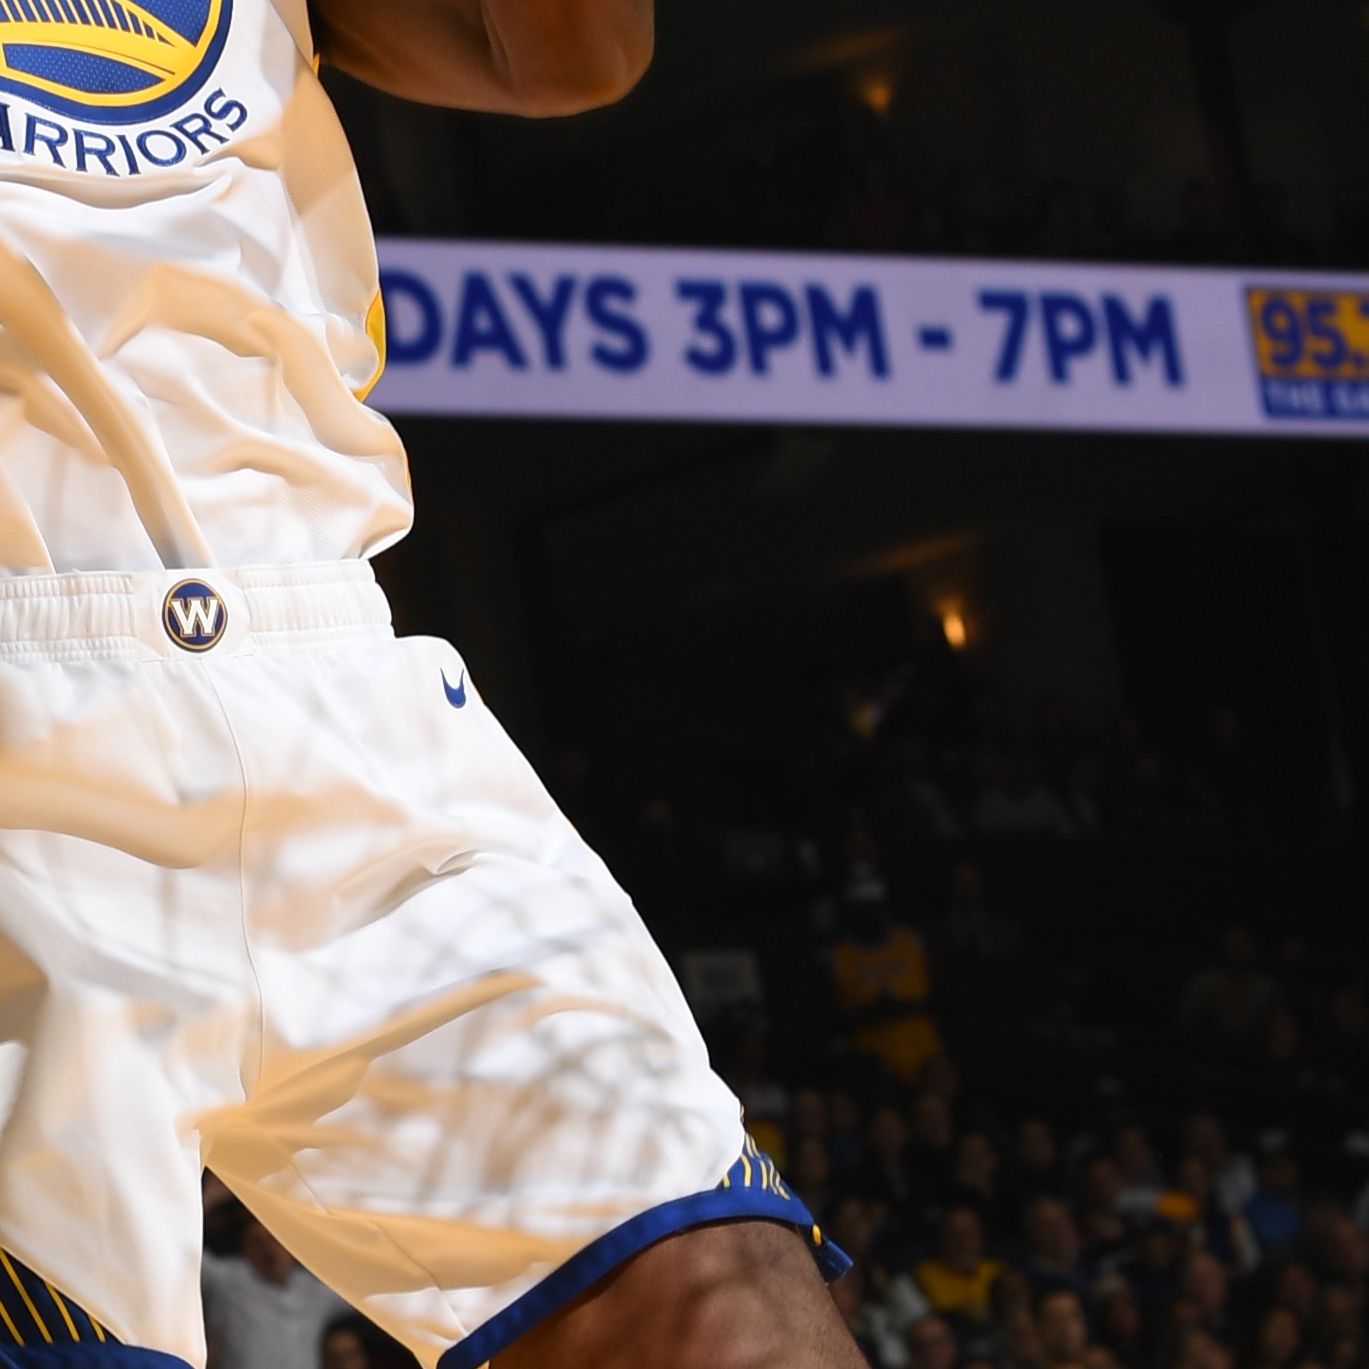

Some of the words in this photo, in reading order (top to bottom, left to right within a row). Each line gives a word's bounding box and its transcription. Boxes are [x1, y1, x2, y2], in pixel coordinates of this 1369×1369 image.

[379, 268, 648, 373] DAYS
[676, 278, 891, 381] 3PM
[915, 324, 952, 351] -
[977, 289, 1186, 388] 7PM
[1261, 297, 1369, 365] 95.
[170, 596, 221, 639] W
